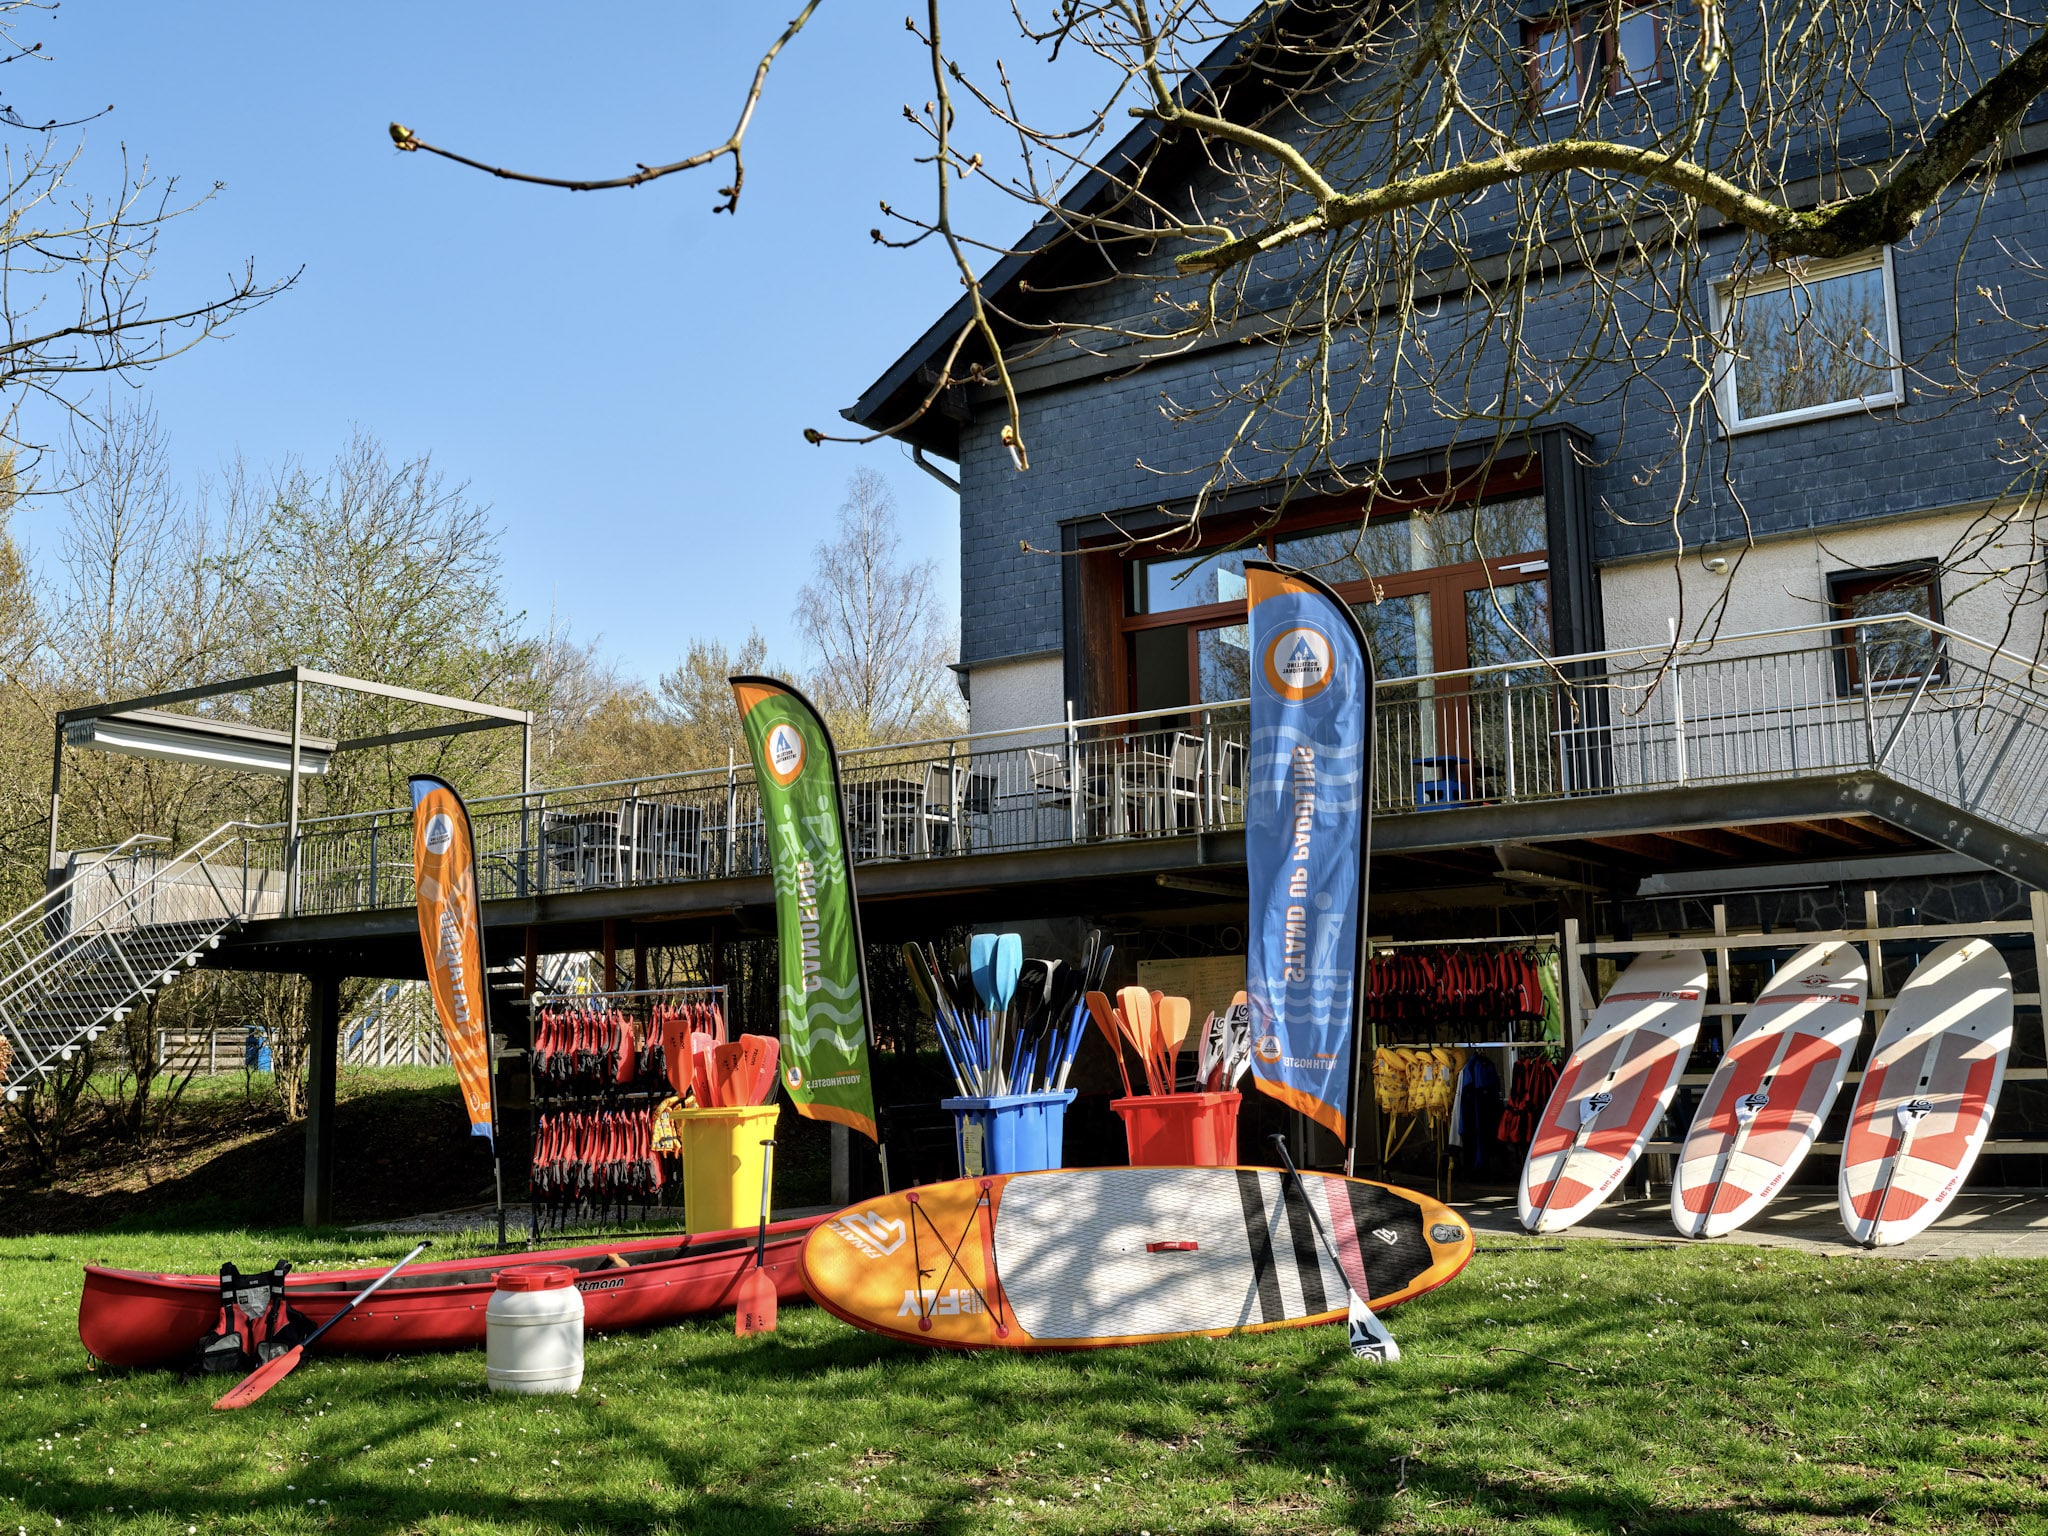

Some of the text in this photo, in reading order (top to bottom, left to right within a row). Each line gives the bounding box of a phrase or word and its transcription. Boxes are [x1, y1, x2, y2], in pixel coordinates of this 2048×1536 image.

[1760, 1174, 1782, 1198] BIC SUP
[1935, 1178, 1956, 1202] BIC SUP
[826, 1220, 882, 1259] FANATIC
[574, 1277, 625, 1292] ttmann
[896, 1288, 960, 1317] FLY
[960, 1288, 971, 1314] AIR
